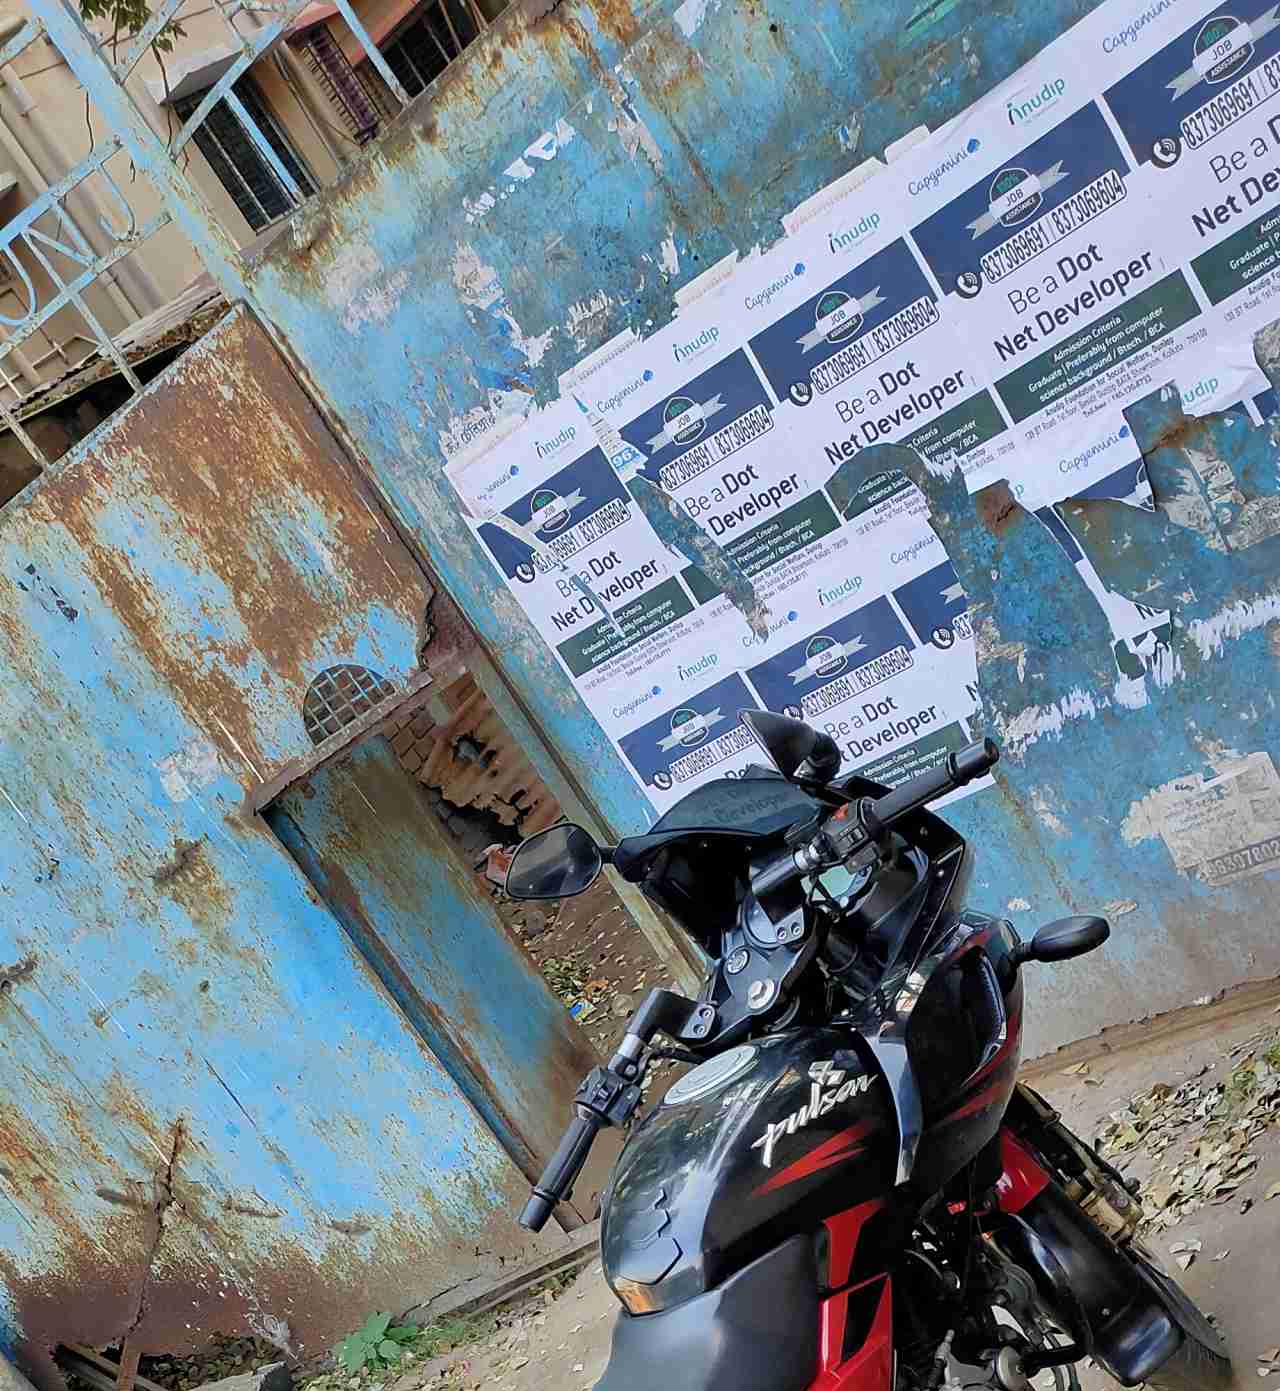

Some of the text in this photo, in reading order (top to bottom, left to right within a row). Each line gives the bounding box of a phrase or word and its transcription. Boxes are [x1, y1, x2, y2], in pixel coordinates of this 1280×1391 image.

[1212, 39, 1233, 60] JOB
[1181, 76, 1260, 147] 8373069691
[908, 146, 968, 195] Capgemini
[1209, 137, 1268, 183] Be a
[1006, 189, 1024, 207] JOB
[1192, 195, 1243, 237] Net
[981, 223, 1051, 281] 8373069691
[1053, 170, 1123, 235] 8373069604
[1007, 243, 1103, 315] Be a Dot
[1230, 241, 1270, 270] Graduate
[994, 325, 1038, 362] Net
[1034, 252, 1152, 336] Developer
[1148, 322, 1166, 338] BCA
[812, 341, 871, 391] 8373069691
[873, 300, 936, 352] 8373069604
[1028, 368, 1063, 393] Graduate
[1066, 337, 1106, 369] Preferably
[1105, 330, 1124, 347] from
[1124, 307, 1164, 336] computer
[1052, 316, 1121, 363] Admission Criteria
[836, 361, 920, 423] Be a Dot
[714, 407, 771, 455] 8373069604
[824, 433, 864, 465] Net
[861, 369, 965, 443] Developer
[942, 419, 977, 445] computer
[1059, 436, 1119, 474] Capgemini
[684, 464, 760, 518] Be a Dot
[707, 473, 801, 537] Developer
[588, 550, 622, 576] Dot
[551, 559, 659, 631] Net Dveloper
[719, 726, 754, 757] 8373069
[824, 696, 899, 741] Be a Dot
[847, 704, 937, 758] Developer
[751, 1074, 878, 1168] pulsar
